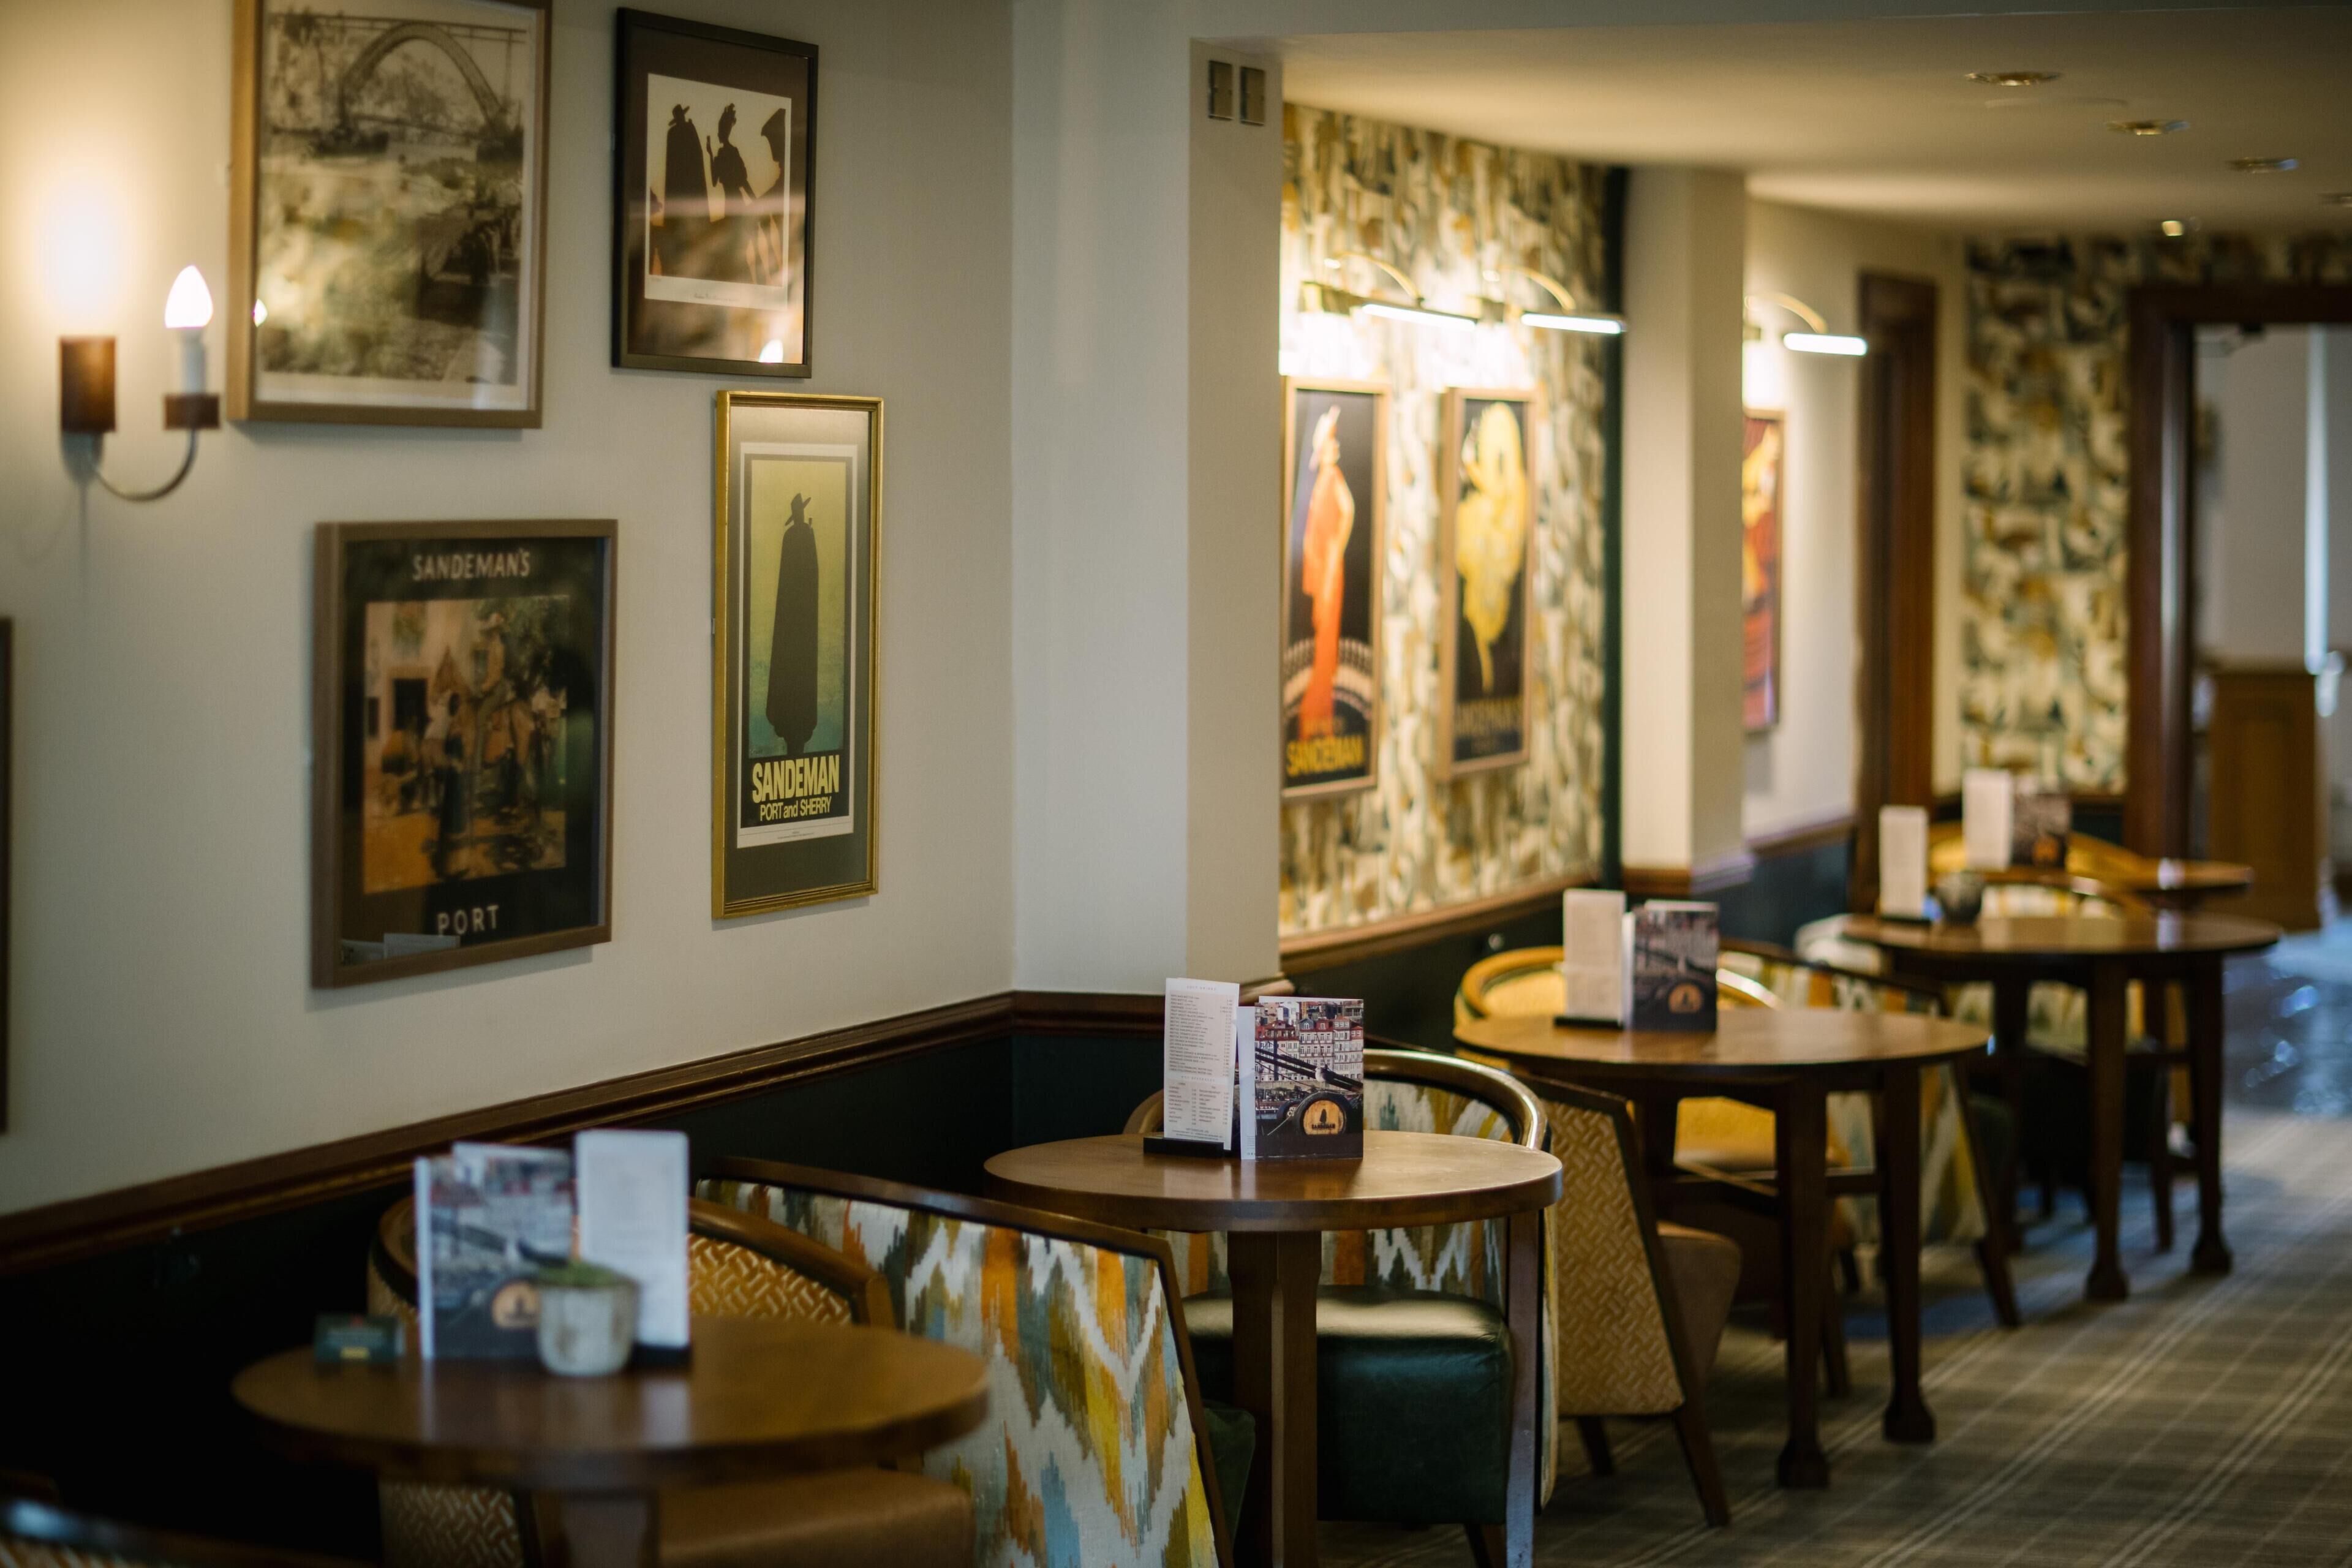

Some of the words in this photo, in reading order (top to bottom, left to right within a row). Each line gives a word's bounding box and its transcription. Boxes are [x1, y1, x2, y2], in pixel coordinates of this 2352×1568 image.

[412, 548, 530, 581] SANDEMAN'S
[753, 755, 840, 803] SANDEMAN
[760, 802, 783, 821] PORT
[783, 801, 798, 818] and
[800, 796, 832, 816] SHERRY
[437, 905, 499, 936] PORT
